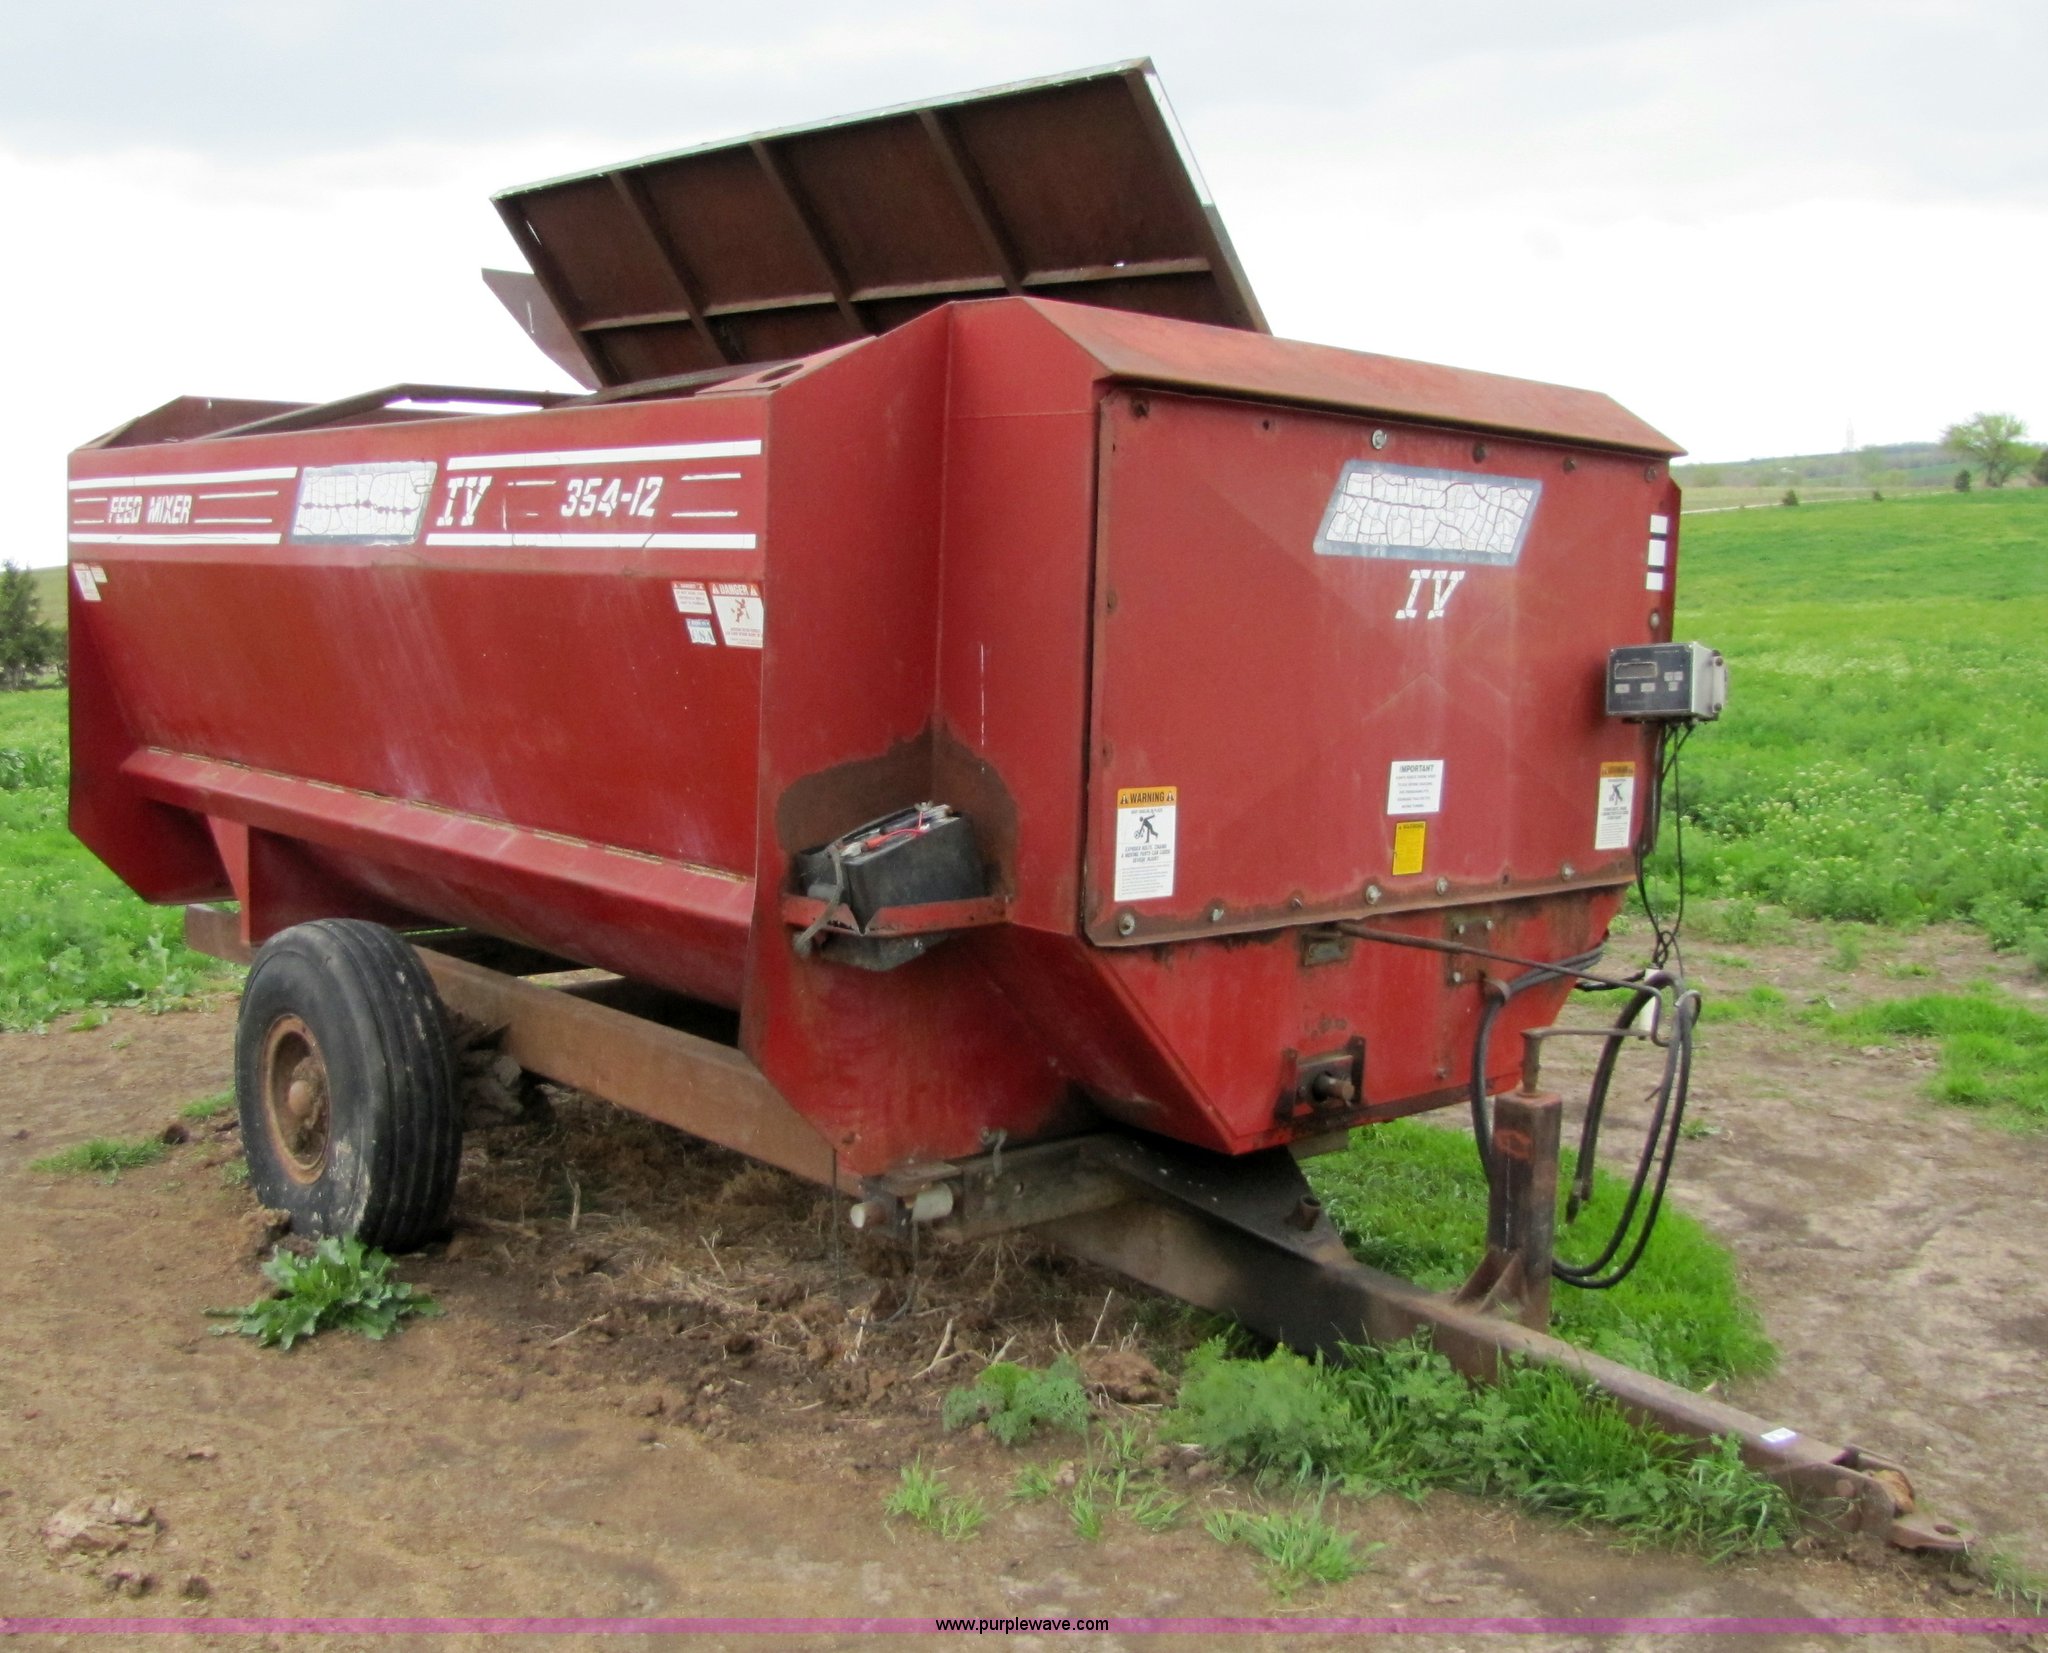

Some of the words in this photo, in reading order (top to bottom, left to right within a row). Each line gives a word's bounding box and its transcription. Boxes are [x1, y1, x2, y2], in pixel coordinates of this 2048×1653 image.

[108, 495, 143, 523] FEED
[148, 495, 192, 524] MIXER
[437, 476, 492, 526] IV
[561, 477, 663, 517] 354-12
[718, 584, 749, 596] DANGER
[1395, 569, 1465, 619] IV
[1399, 764, 1434, 773] IMPORTANT
[1130, 791, 1165, 803] WARNING
